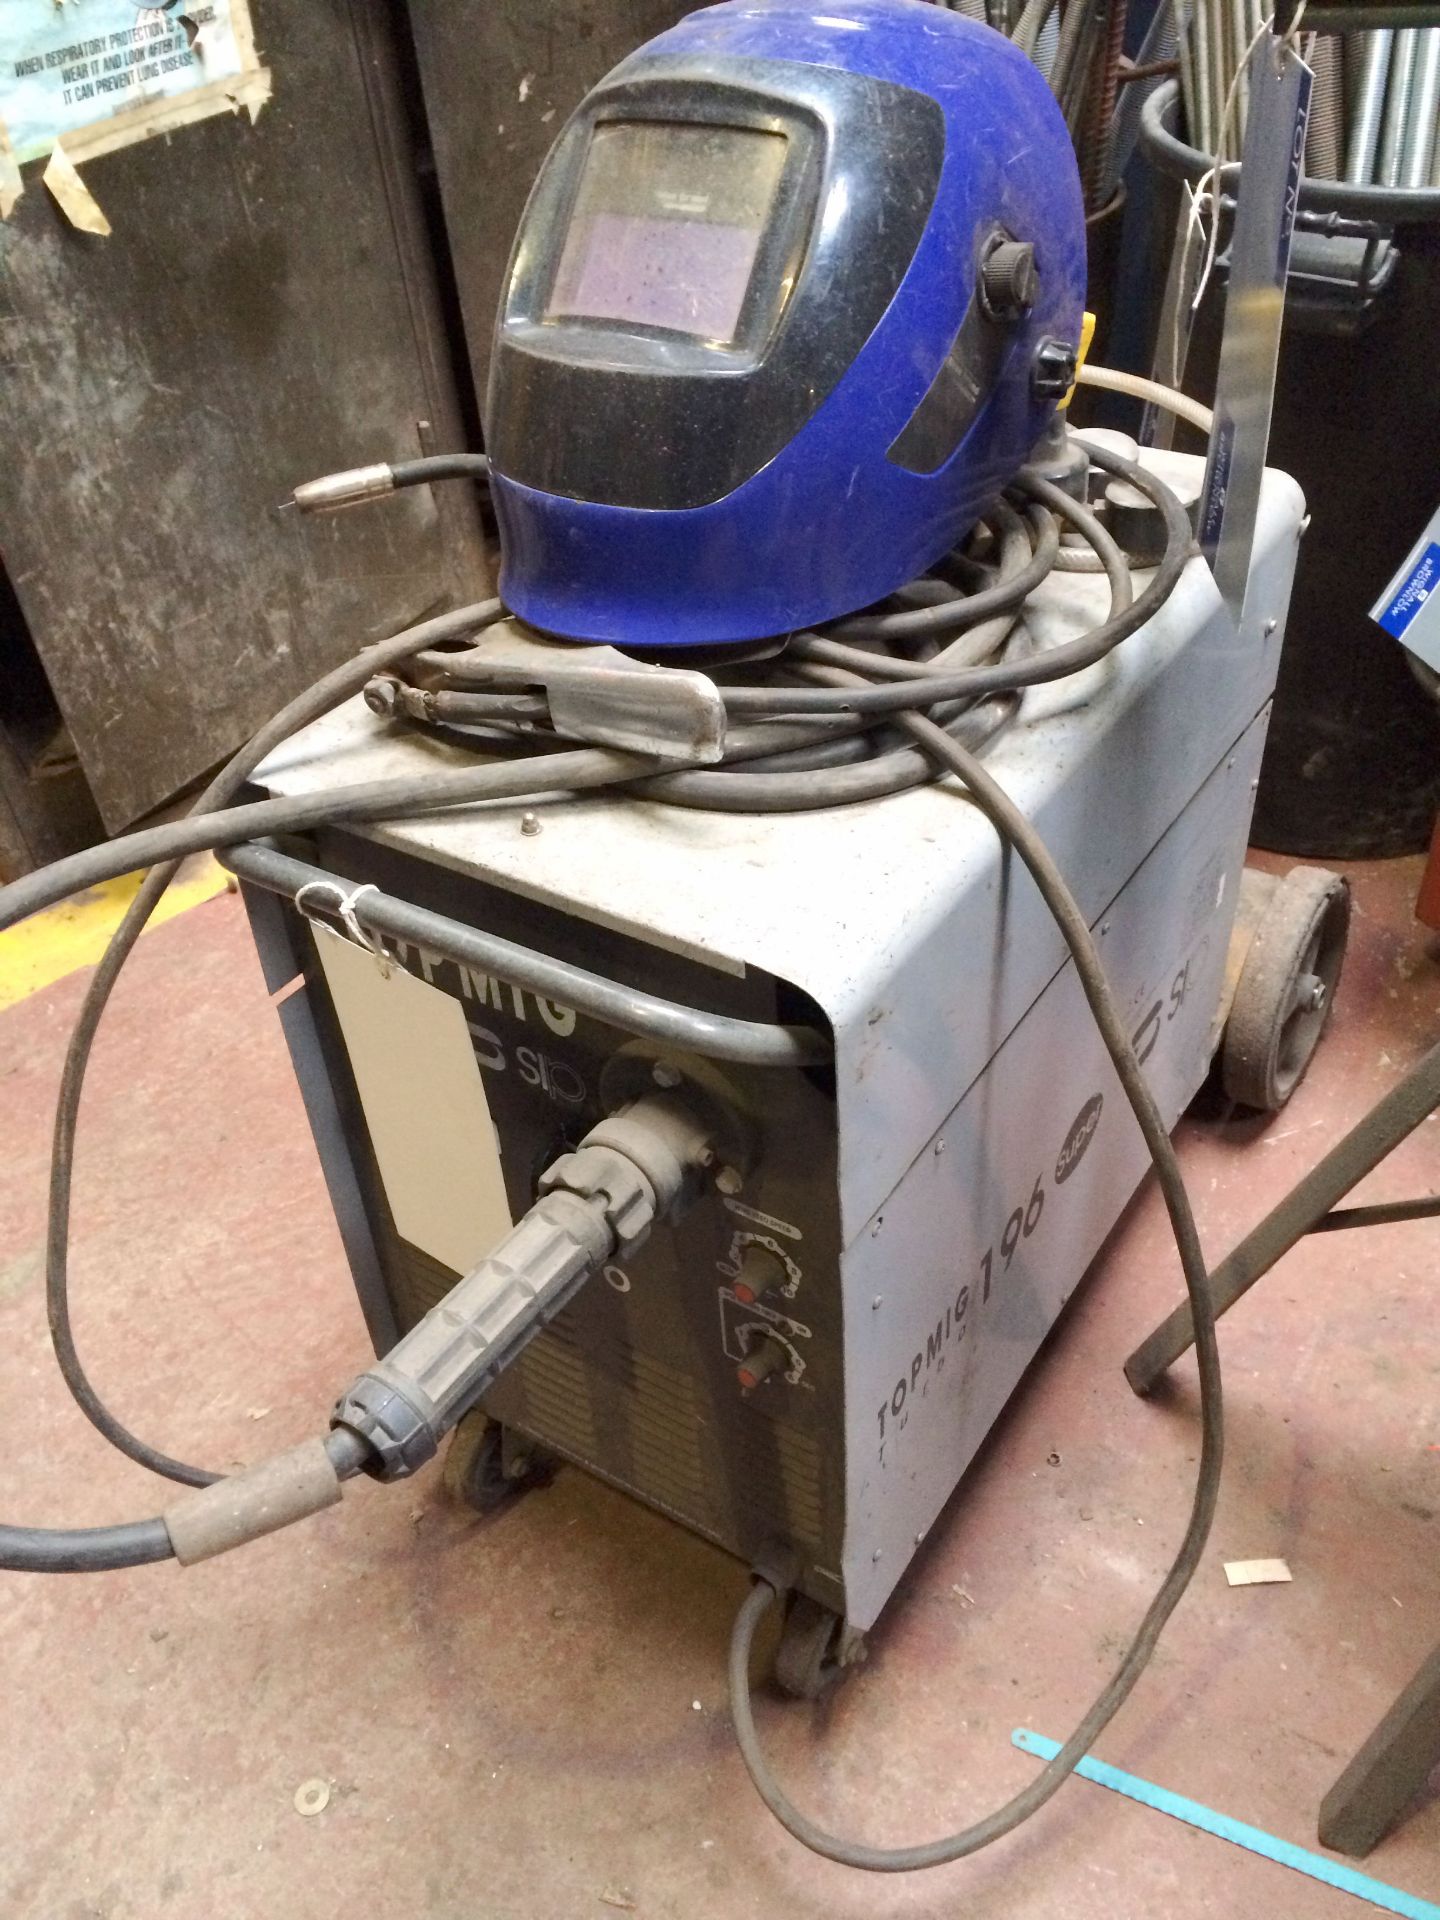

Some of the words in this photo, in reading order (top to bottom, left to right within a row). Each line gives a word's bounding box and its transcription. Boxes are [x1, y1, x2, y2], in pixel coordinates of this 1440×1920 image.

[14, 56, 44, 77] WHEN
[45, 36, 107, 69] RESPIRATORY
[109, 22, 164, 49] PROTECTION
[166, 17, 175, 33] IS
[62, 63, 88, 84] WEAR
[91, 59, 99, 75] IT
[104, 54, 121, 72] AND
[124, 46, 145, 66] LOOK
[149, 39, 172, 57] AFTER
[63, 89, 72, 105] IT
[75, 82, 94, 101] CAN
[96, 70, 134, 96] PREVENT
[137, 62, 160, 82] LUNG
[161, 51, 193, 74] DISEASE
[1391, 557, 1433, 617] BROWNLOW
[877, 1284, 969, 1439] TOPMIG
[980, 1171, 1045, 1305] 196
